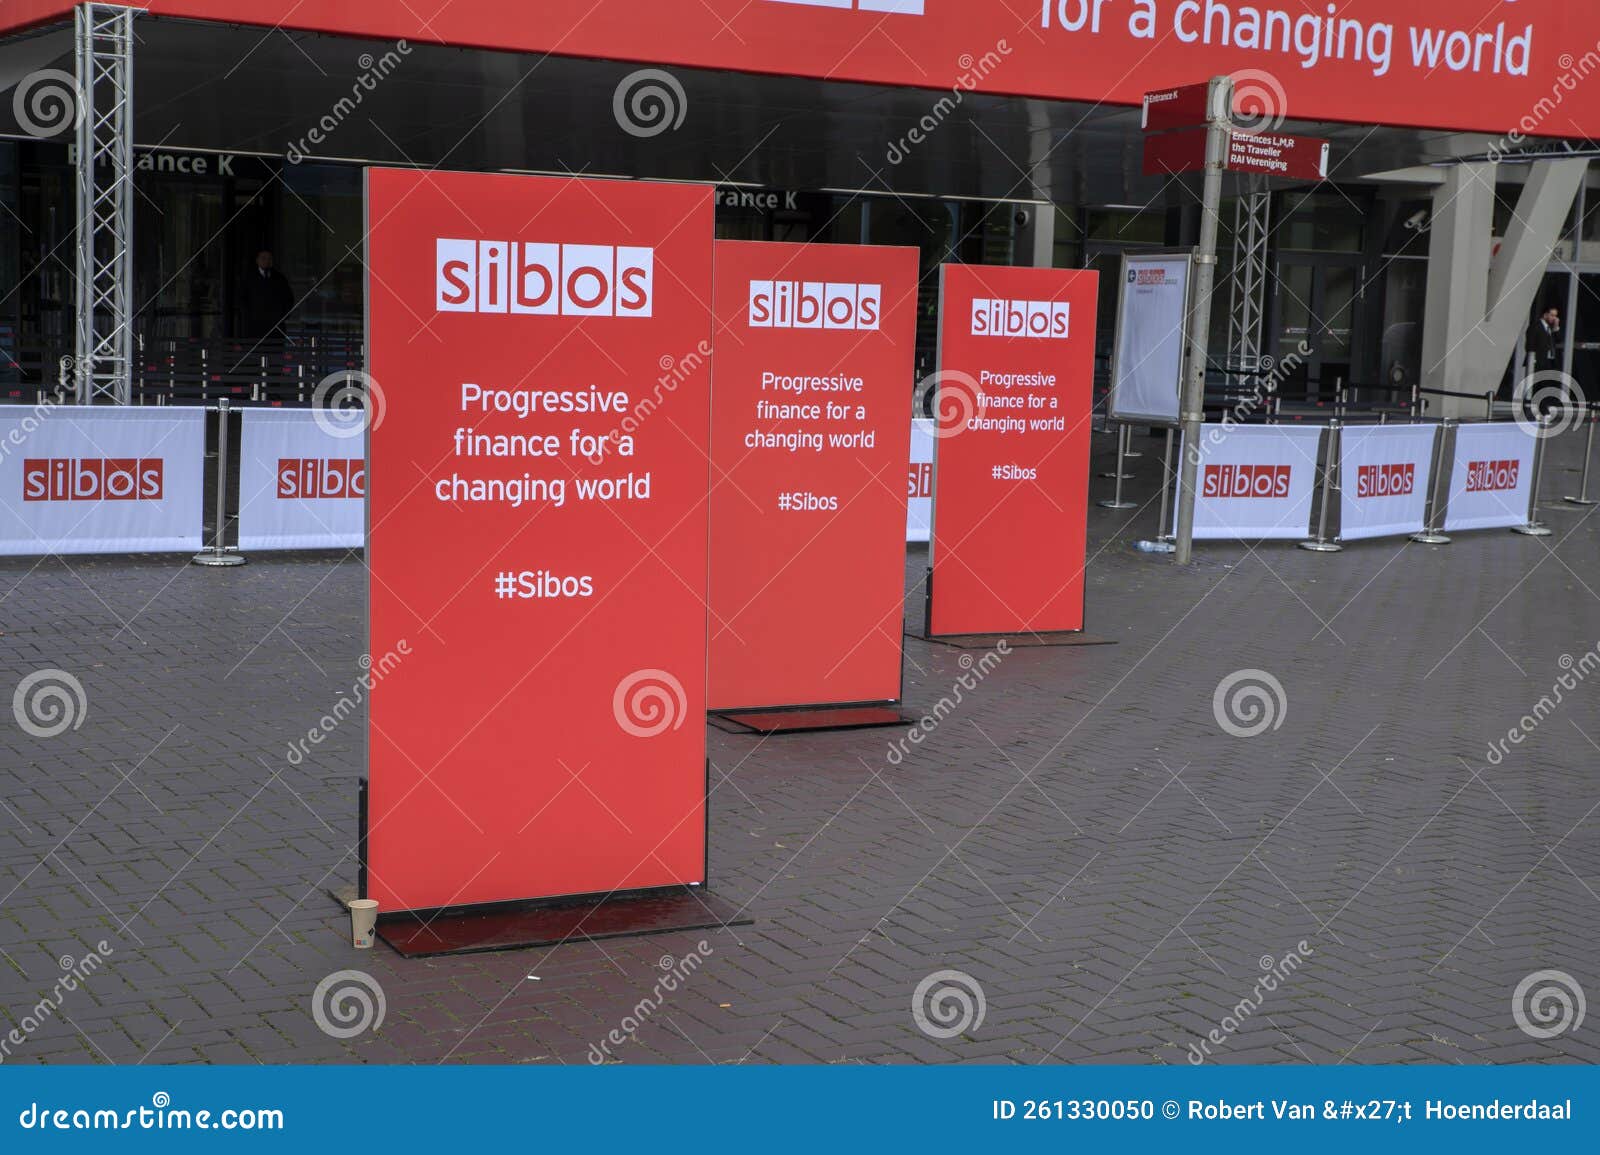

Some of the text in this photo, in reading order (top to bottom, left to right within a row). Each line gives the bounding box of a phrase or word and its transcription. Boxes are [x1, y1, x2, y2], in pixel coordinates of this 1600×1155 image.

[1128, 0, 1156, 39] a
[1174, 0, 1394, 77] changing
[1409, 22, 1533, 76] world
[1232, 132, 1272, 145] Entrances
[1232, 143, 1281, 157] the Traveller
[218, 155, 235, 176] K
[1231, 154, 1288, 171] RAI Vereniging
[715, 190, 798, 210] rance K
[440, 242, 649, 312] sibos
[751, 283, 878, 326] sibos
[974, 301, 1067, 334] sibos
[762, 372, 864, 395] Progressive
[980, 370, 1056, 389] Progressive
[461, 383, 629, 419] Progressive
[757, 400, 866, 420] finance for a
[977, 392, 1058, 409] finance for a
[967, 416, 1065, 434] changing world
[453, 427, 634, 457] finance for a
[744, 430, 875, 452] changing world
[27, 459, 160, 497] sibos
[280, 459, 365, 495] sibo
[991, 465, 1037, 480] #Sibos
[1205, 465, 1290, 496] sibos
[1359, 464, 1414, 496] sibos
[1467, 461, 1519, 490] sibos
[435, 472, 651, 507] changing world
[778, 492, 838, 511] #Sibos
[494, 570, 593, 599] #Sibos
